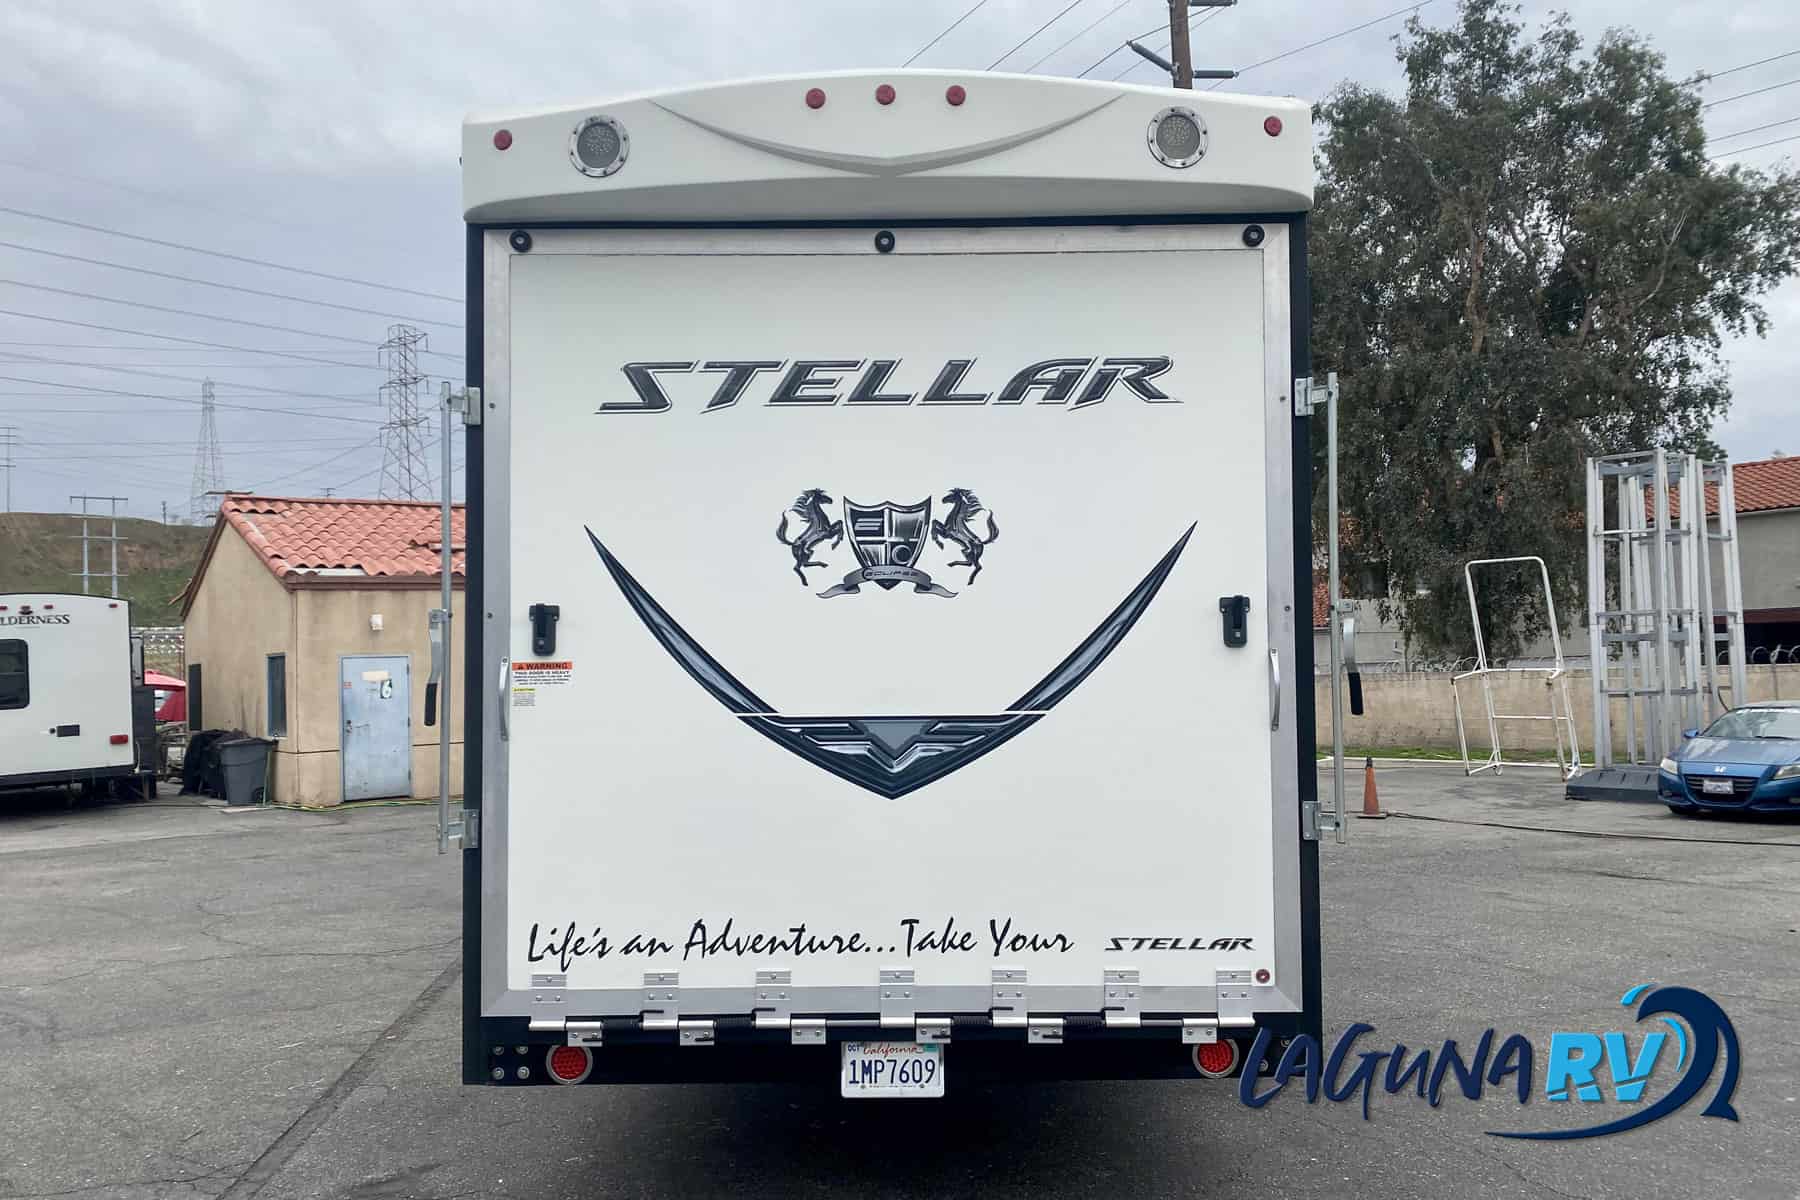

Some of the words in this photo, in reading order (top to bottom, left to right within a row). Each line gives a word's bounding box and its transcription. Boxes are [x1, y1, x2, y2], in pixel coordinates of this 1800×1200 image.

[594, 355, 1185, 414] STELLAR
[527, 662, 568, 670] WARNING
[528, 921, 612, 972] Life's
[619, 934, 673, 957] an
[989, 917, 1075, 957] Your
[1104, 937, 1255, 952] STELLAR
[863, 1043, 918, 1058] California
[849, 1059, 936, 1084] 1MP7609
